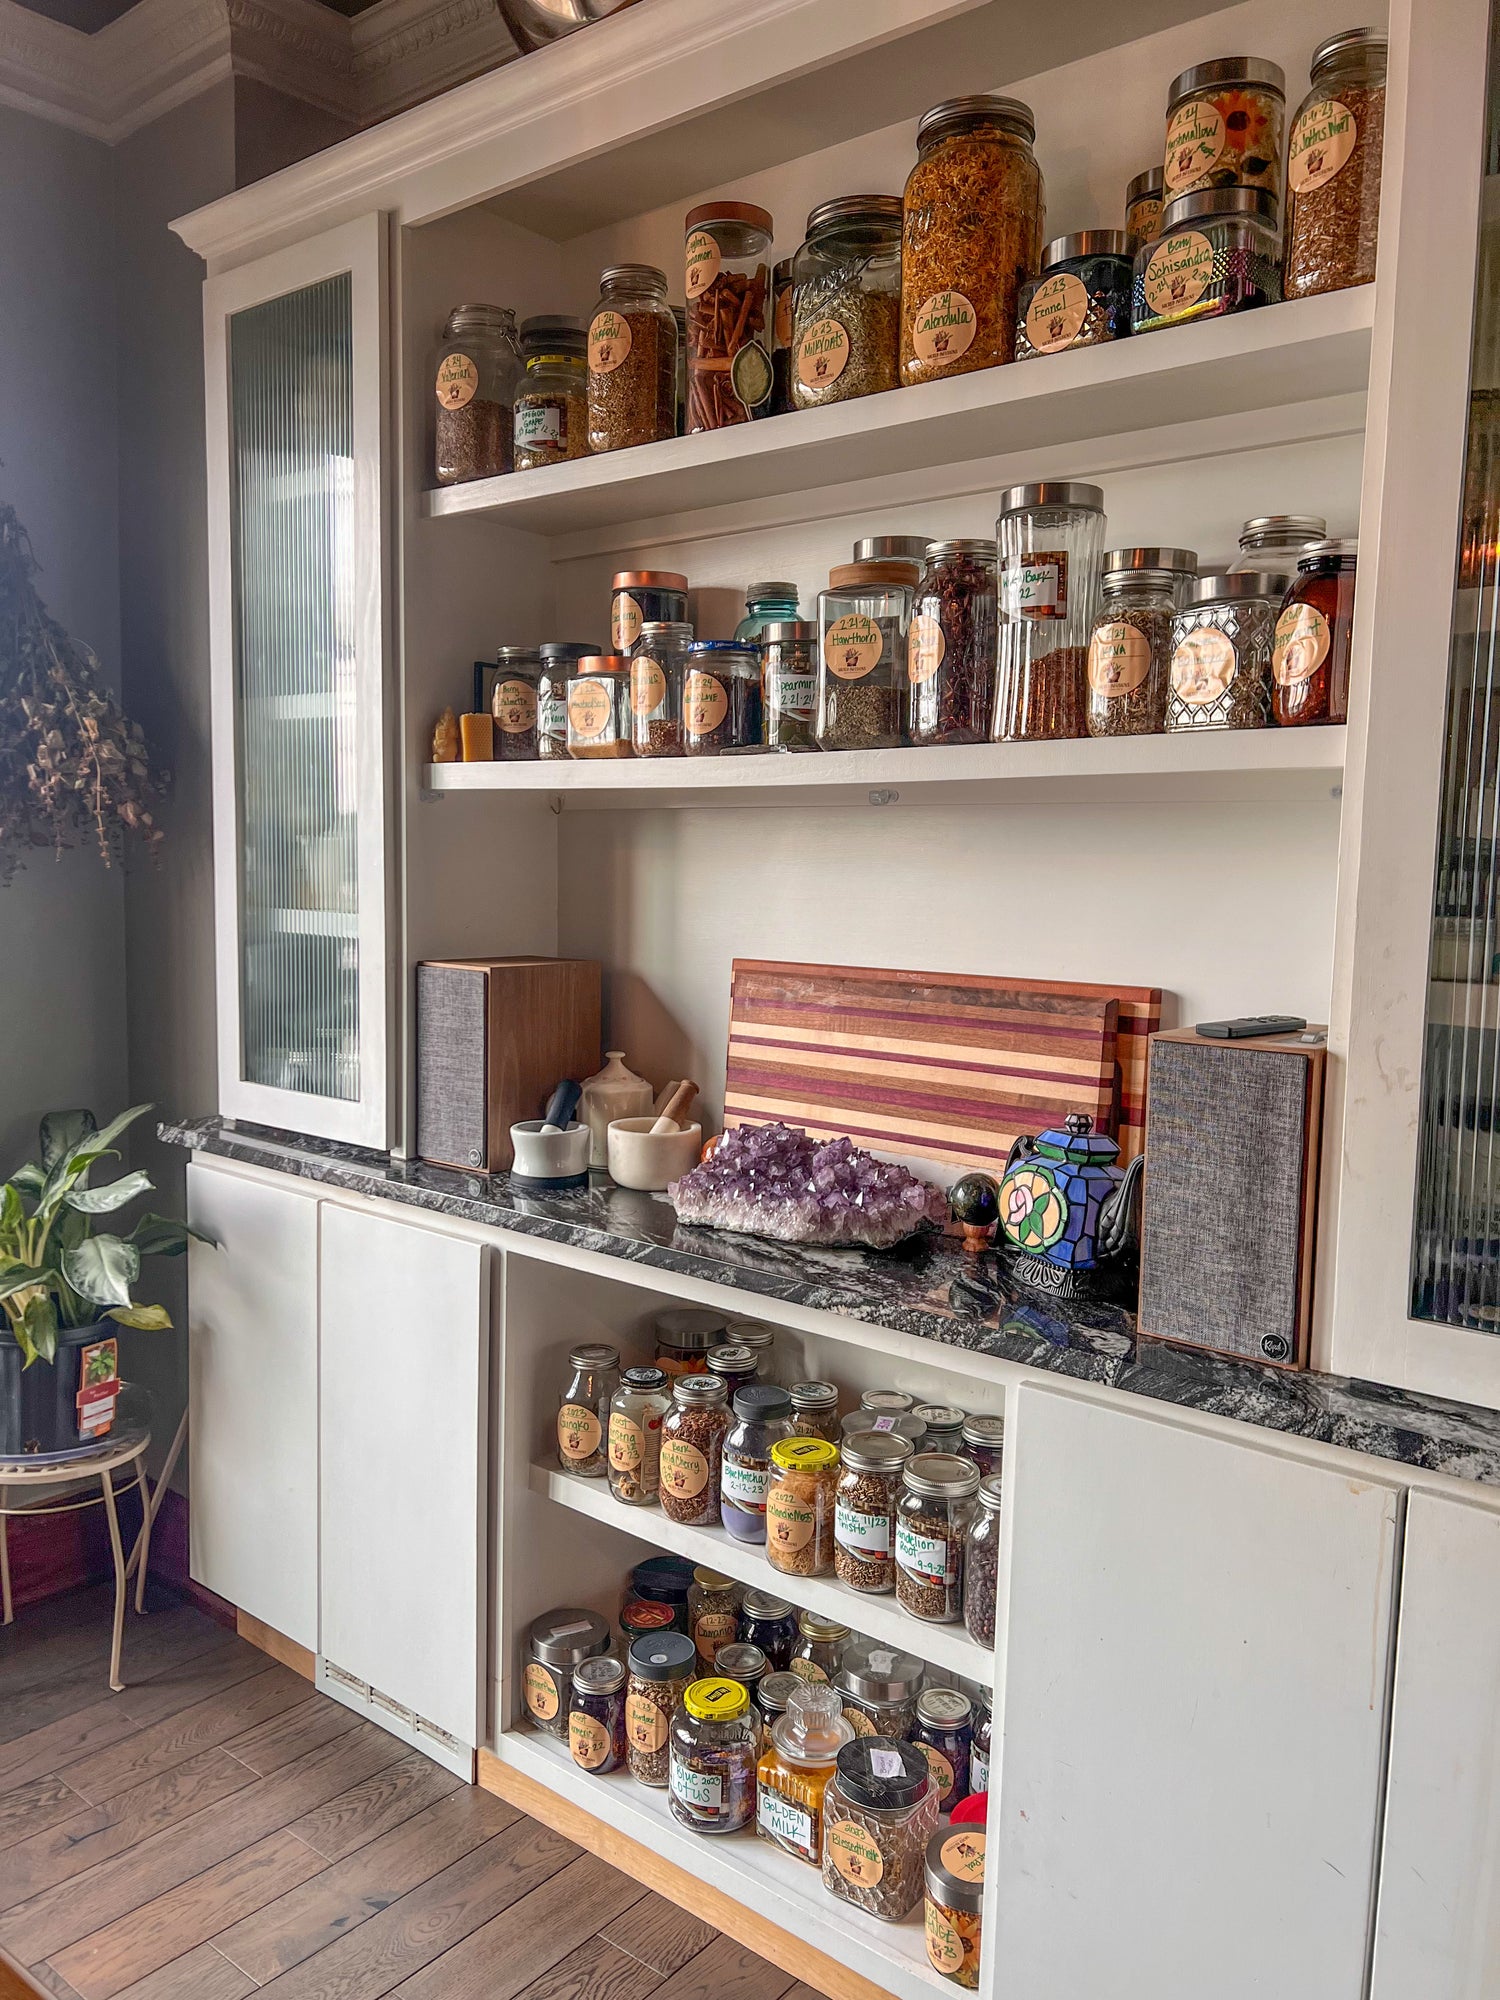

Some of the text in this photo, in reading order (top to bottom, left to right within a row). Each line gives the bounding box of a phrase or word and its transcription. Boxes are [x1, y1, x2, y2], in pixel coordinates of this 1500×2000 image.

[1148, 247, 1212, 282] Schisandra
[917, 308, 973, 334] Calendula
[1034, 294, 1067, 322] Fennel
[832, 632, 877, 646] Hawthorn
[676, 1765, 698, 1786] Blue
